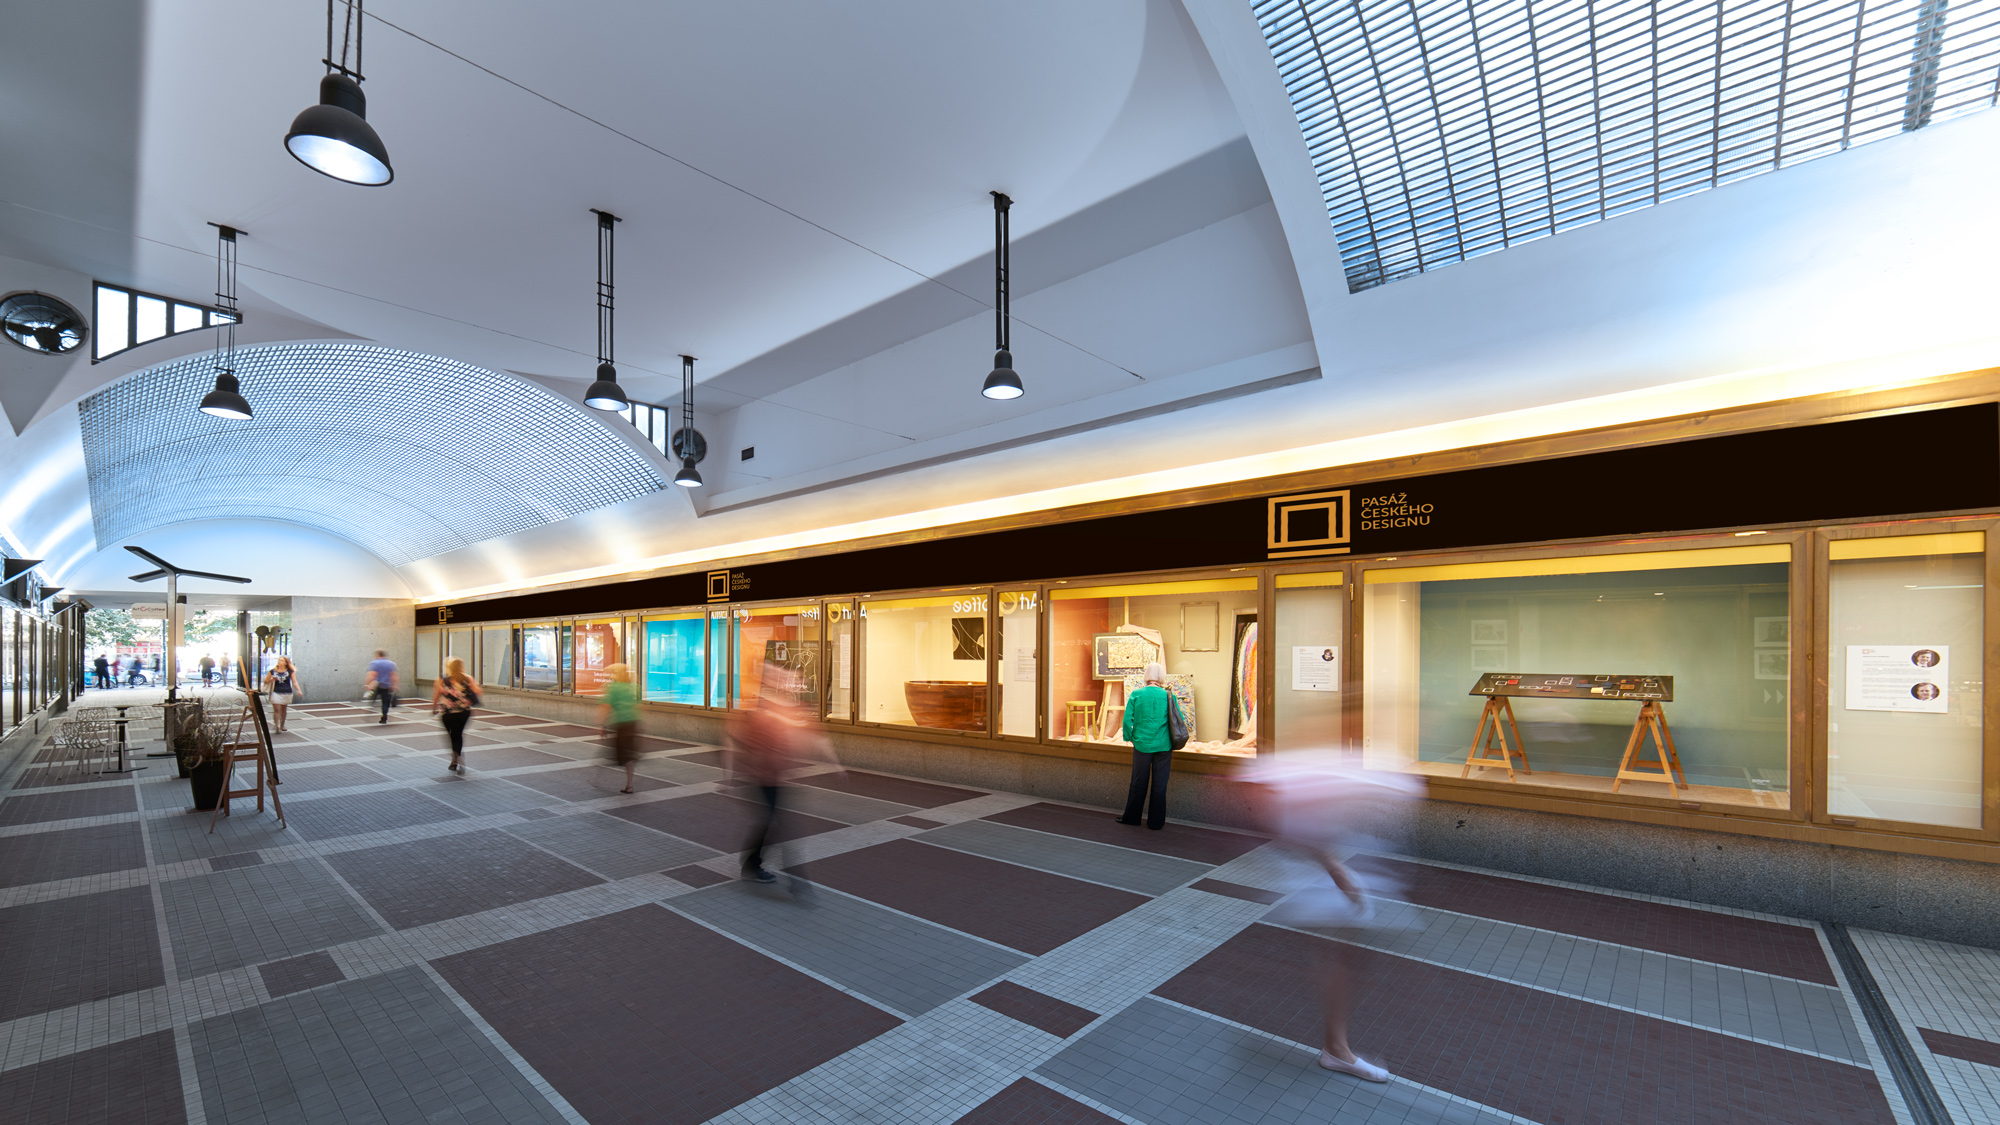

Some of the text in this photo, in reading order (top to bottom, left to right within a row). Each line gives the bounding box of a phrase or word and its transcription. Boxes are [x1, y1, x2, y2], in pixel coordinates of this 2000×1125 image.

[1361, 492, 1407, 507] PASÁŽ
[1361, 503, 1434, 518] ČESKÉHO
[1361, 515, 1430, 530] DESIGNU
